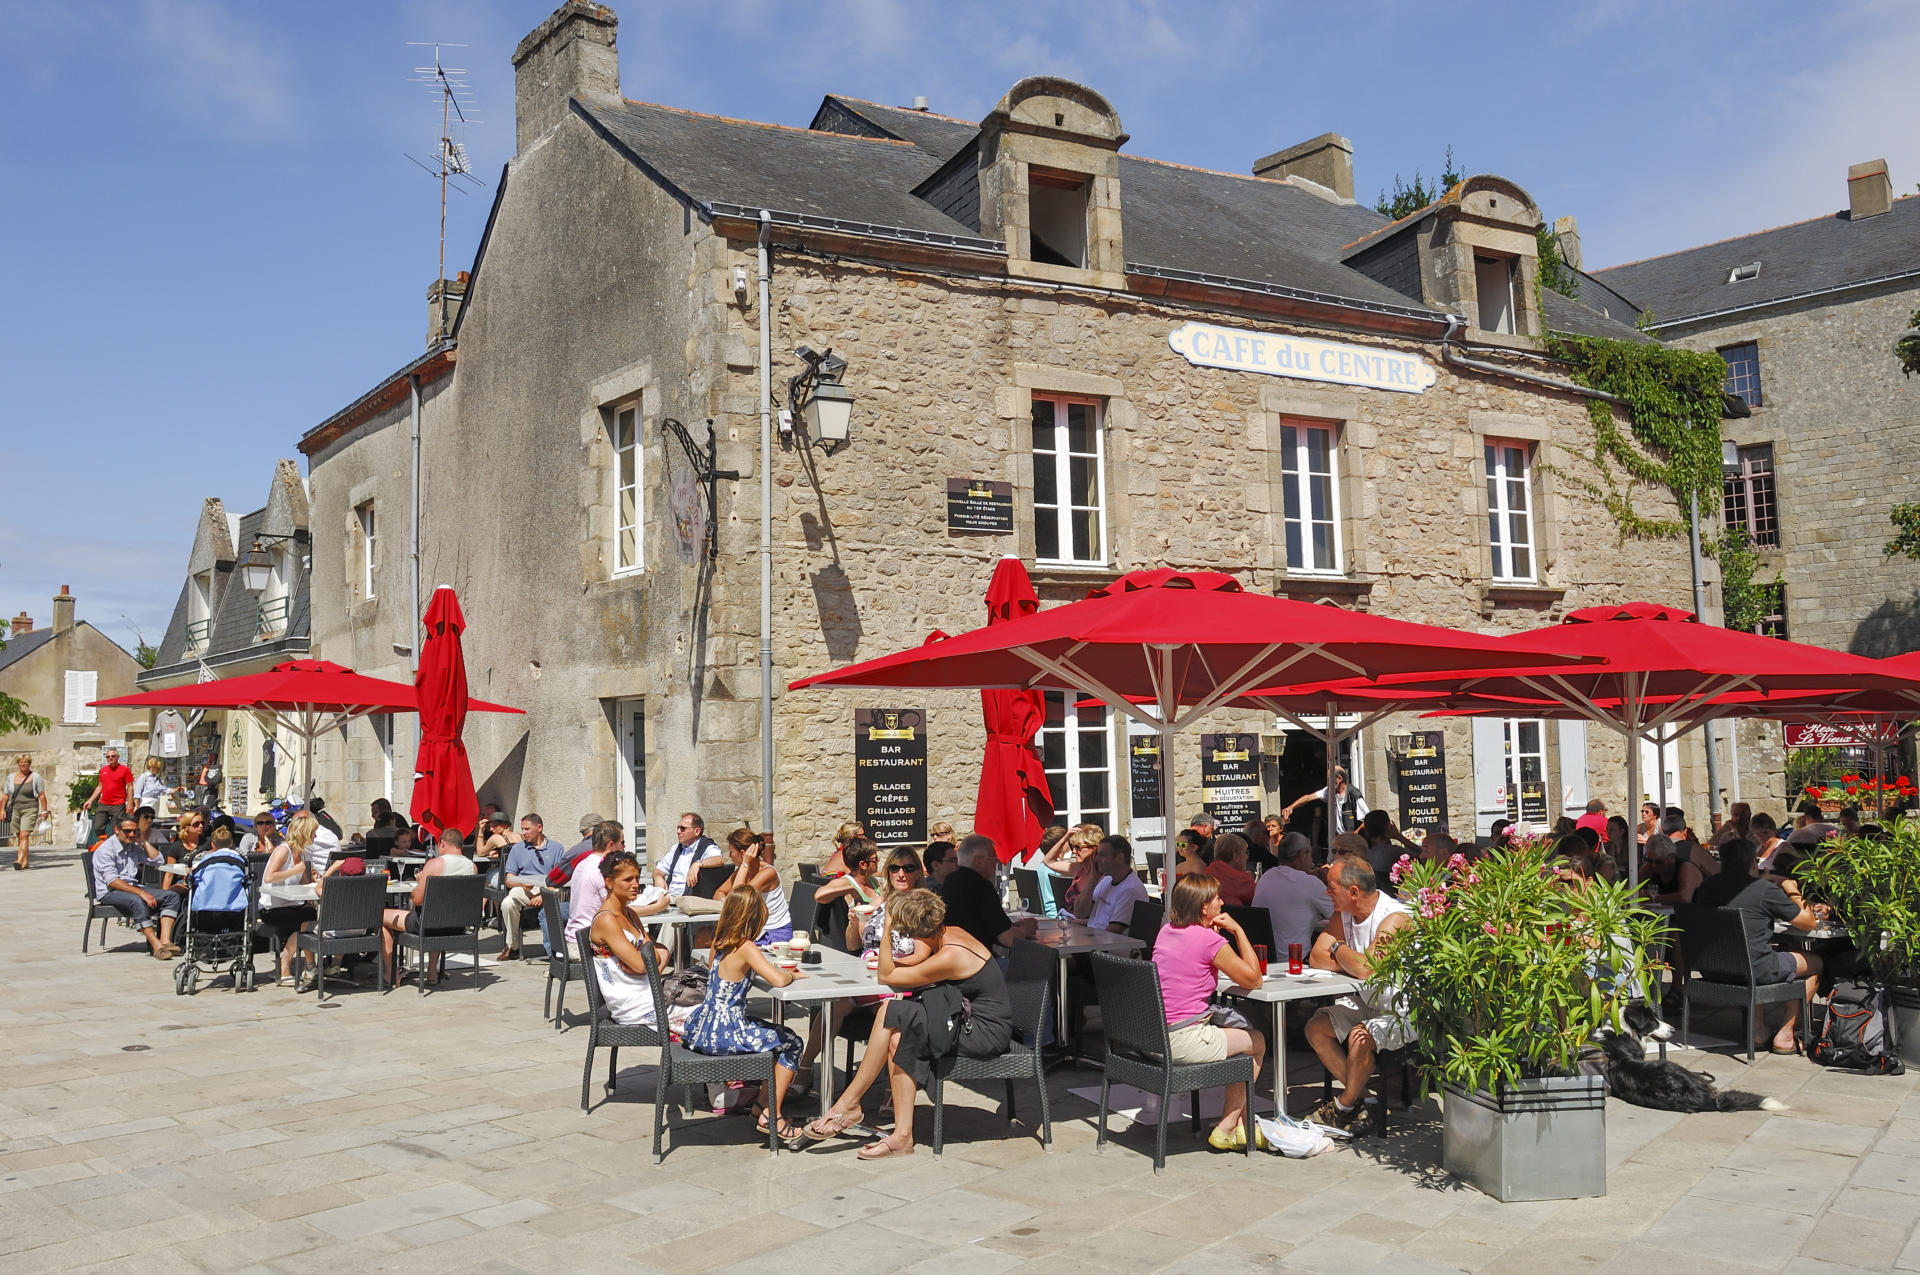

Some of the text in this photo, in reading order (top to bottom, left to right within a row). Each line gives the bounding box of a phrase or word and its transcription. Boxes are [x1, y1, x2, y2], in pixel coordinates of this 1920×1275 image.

[1192, 331, 1418, 386] CAFE du CENTRE
[1795, 732, 1815, 744] Le
[1816, 732, 1852, 744] Vieux
[881, 745, 901, 754] BAR
[859, 758, 924, 767] RESTAURANT
[1400, 767, 1443, 776] RESTAURANT
[1205, 773, 1257, 782] RESTAURANT
[872, 783, 911, 791] SALADES
[1408, 783, 1437, 791] SALADES
[874, 793, 909, 803] CRÊPES
[867, 807, 916, 815] GRILLADES
[1408, 807, 1440, 816] MOULES
[870, 819, 914, 828] POISSONS
[1411, 816, 1438, 824] FRITES
[874, 831, 909, 839] GLACES
